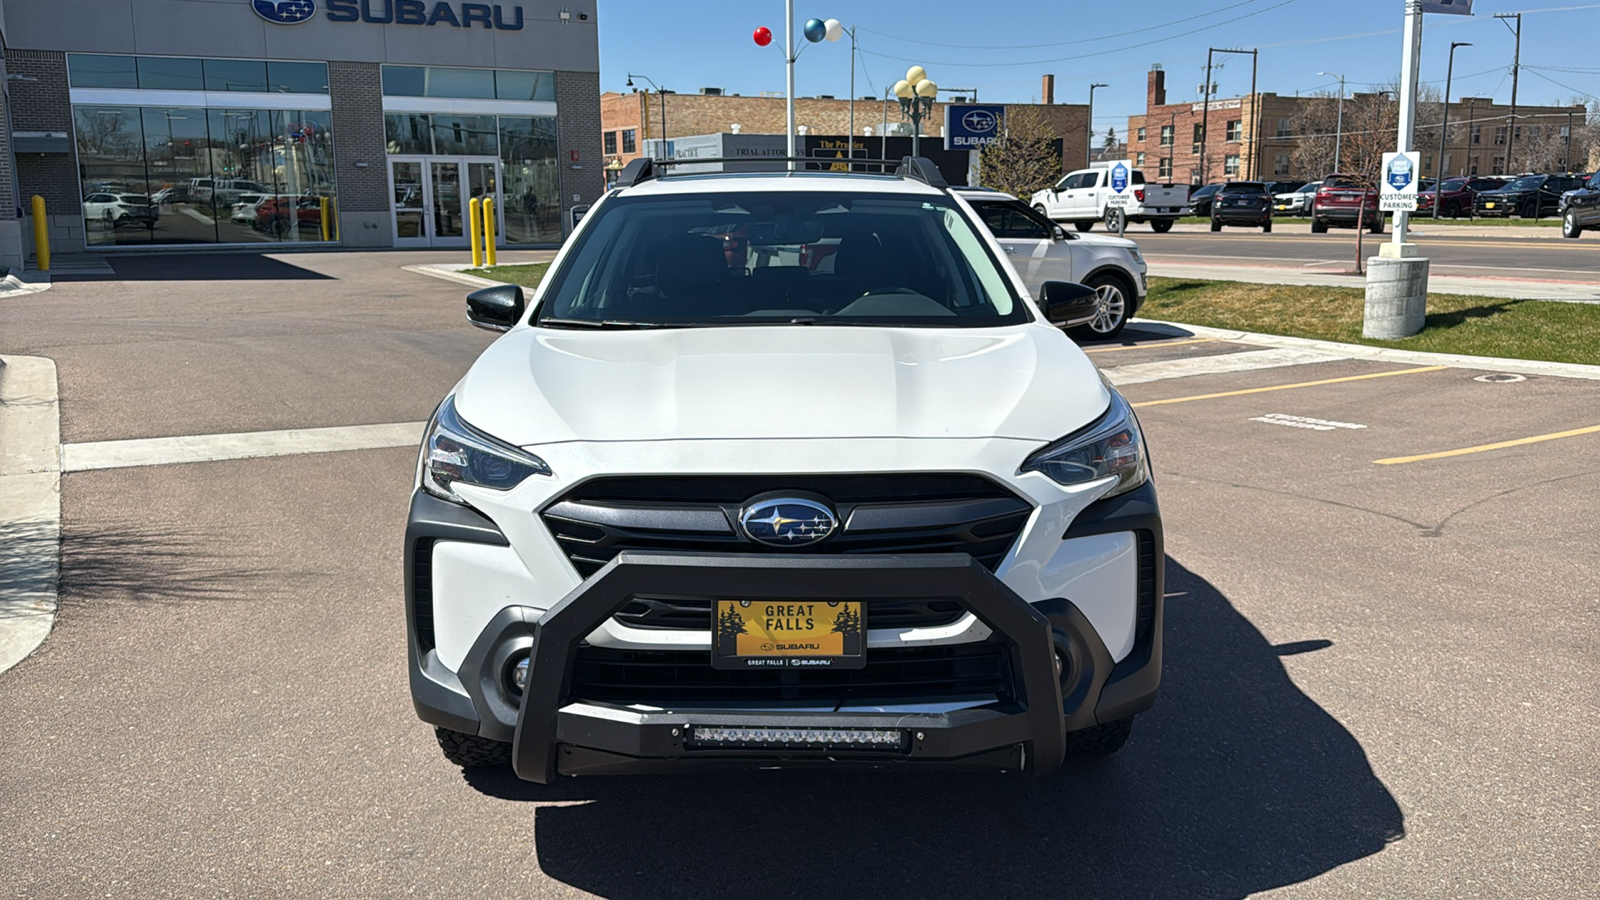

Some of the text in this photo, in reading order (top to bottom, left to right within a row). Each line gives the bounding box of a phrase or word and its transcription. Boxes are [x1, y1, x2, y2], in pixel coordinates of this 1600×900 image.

[326, 0, 524, 31] SUBARU
[835, 140, 865, 149] Praice
[736, 148, 759, 156] TRIAL
[1380, 193, 1417, 201] CUSTOMER
[765, 605, 815, 617] GREAT
[765, 618, 815, 631] FALLS
